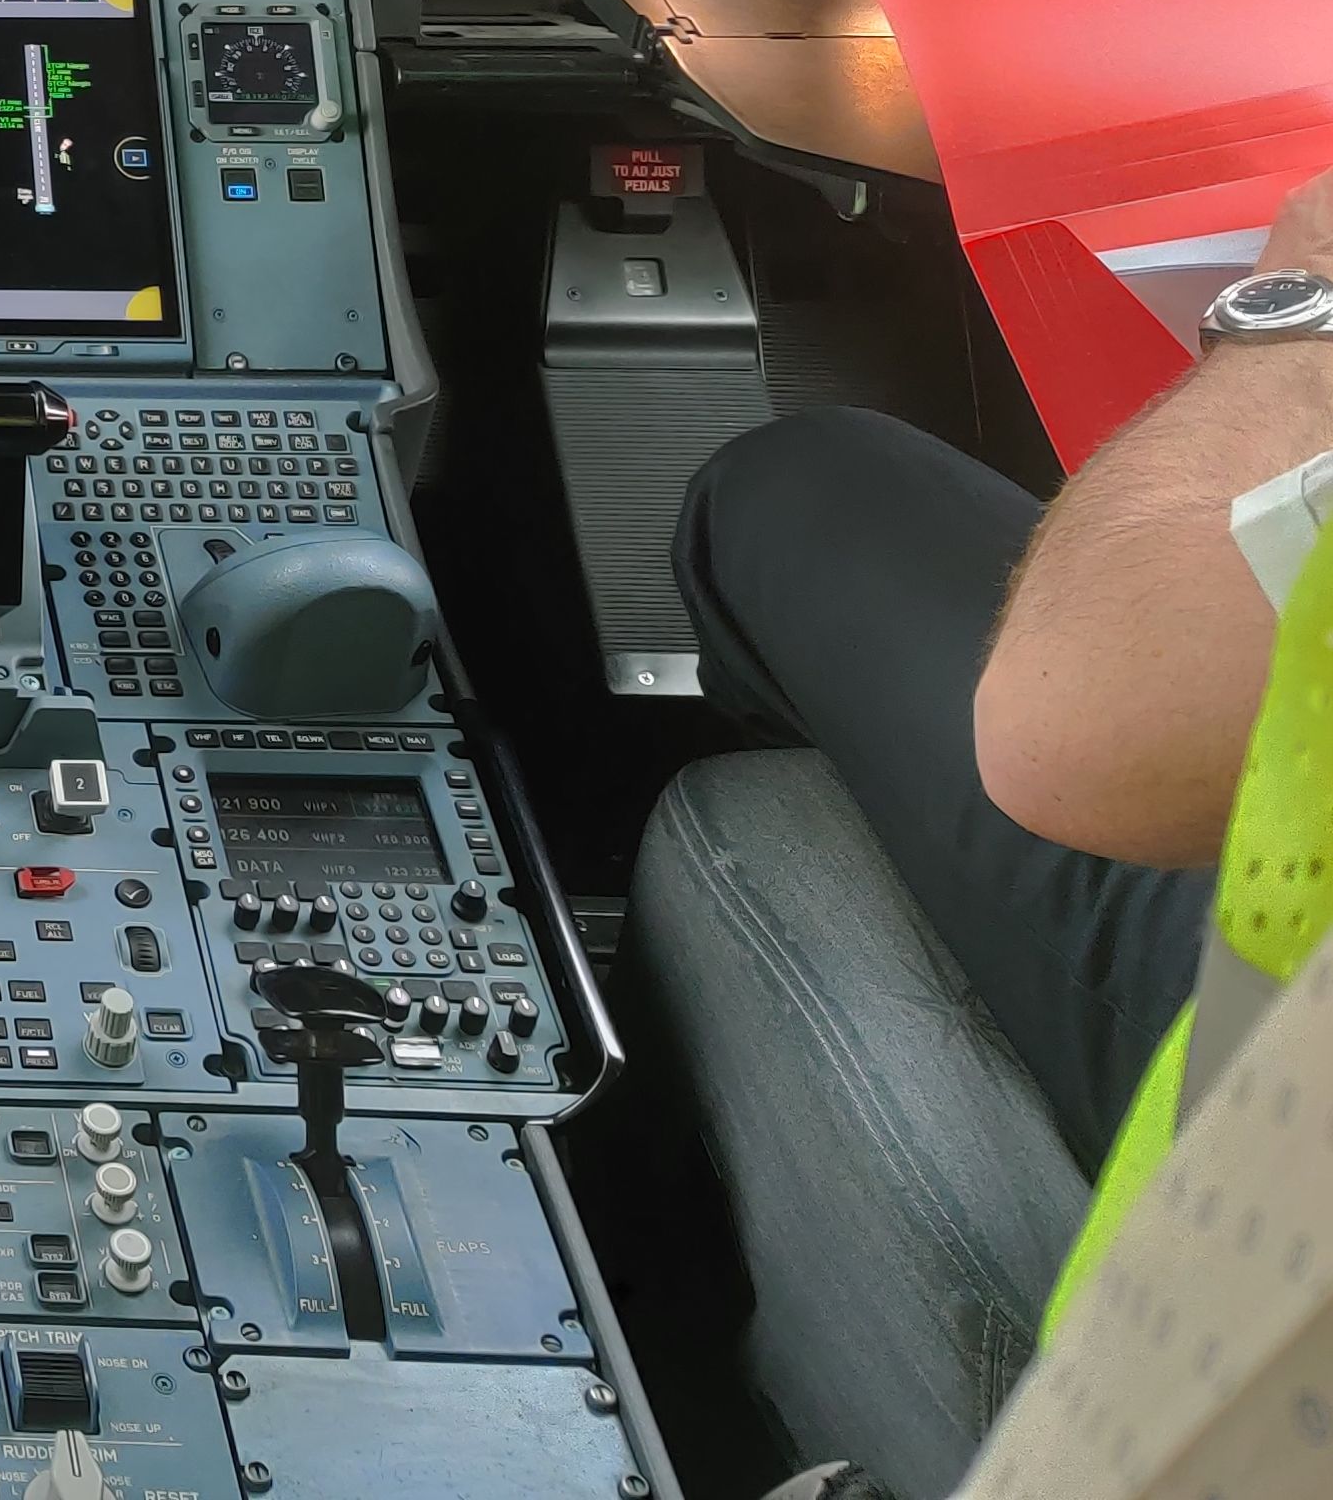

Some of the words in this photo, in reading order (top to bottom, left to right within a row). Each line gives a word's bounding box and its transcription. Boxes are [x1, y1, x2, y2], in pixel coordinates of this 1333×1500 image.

[632, 151, 662, 163] PULL
[613, 165, 628, 176] TO
[625, 180, 670, 191] PEDALS
[75, 778, 84, 790] 2
[237, 860, 284, 873] DATA
[435, 1240, 491, 1255] FLAPS
[299, 1299, 328, 1314] FULL
[401, 1303, 429, 1317] FULL
